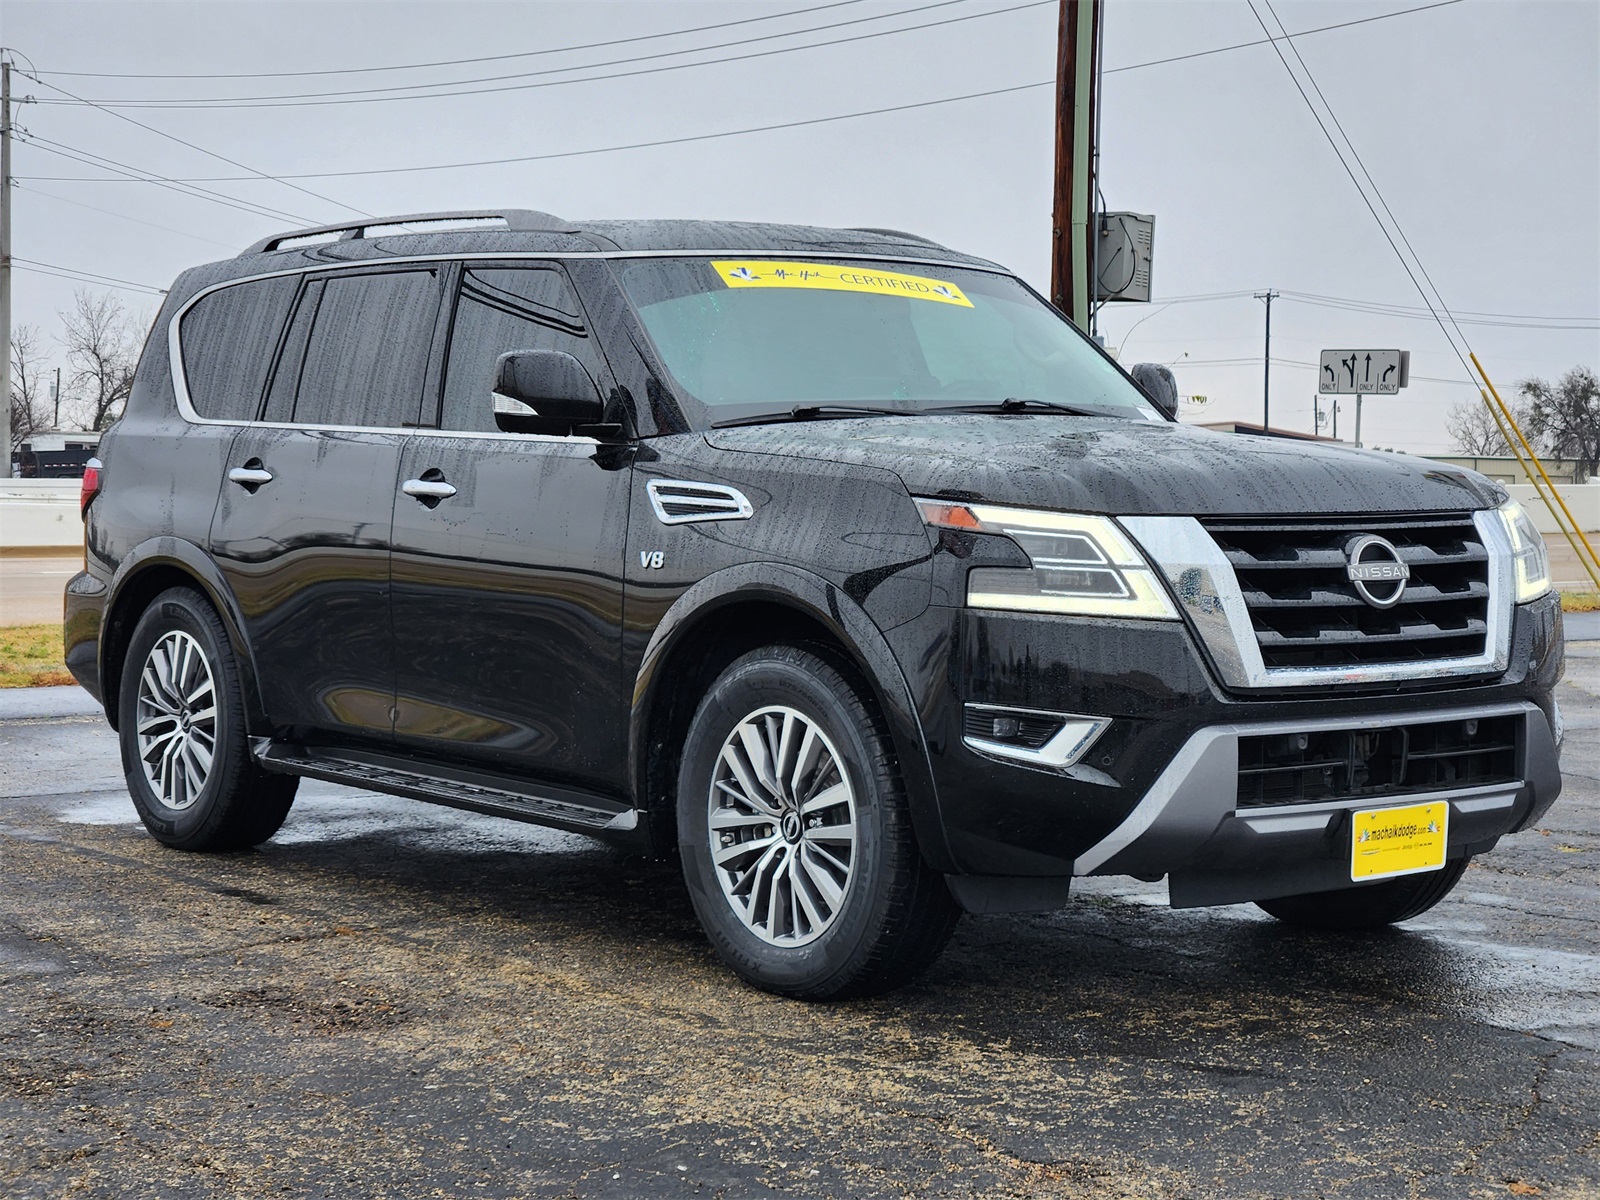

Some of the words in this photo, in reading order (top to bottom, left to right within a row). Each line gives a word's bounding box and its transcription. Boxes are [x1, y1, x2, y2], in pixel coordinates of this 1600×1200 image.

[840, 273, 930, 293] CERTIFIED
[1321, 383, 1337, 391] ONLY
[1359, 383, 1374, 391] ONLY
[1380, 383, 1396, 391] ONLY
[640, 550, 664, 569] V8
[1350, 566, 1410, 579] NISSAN
